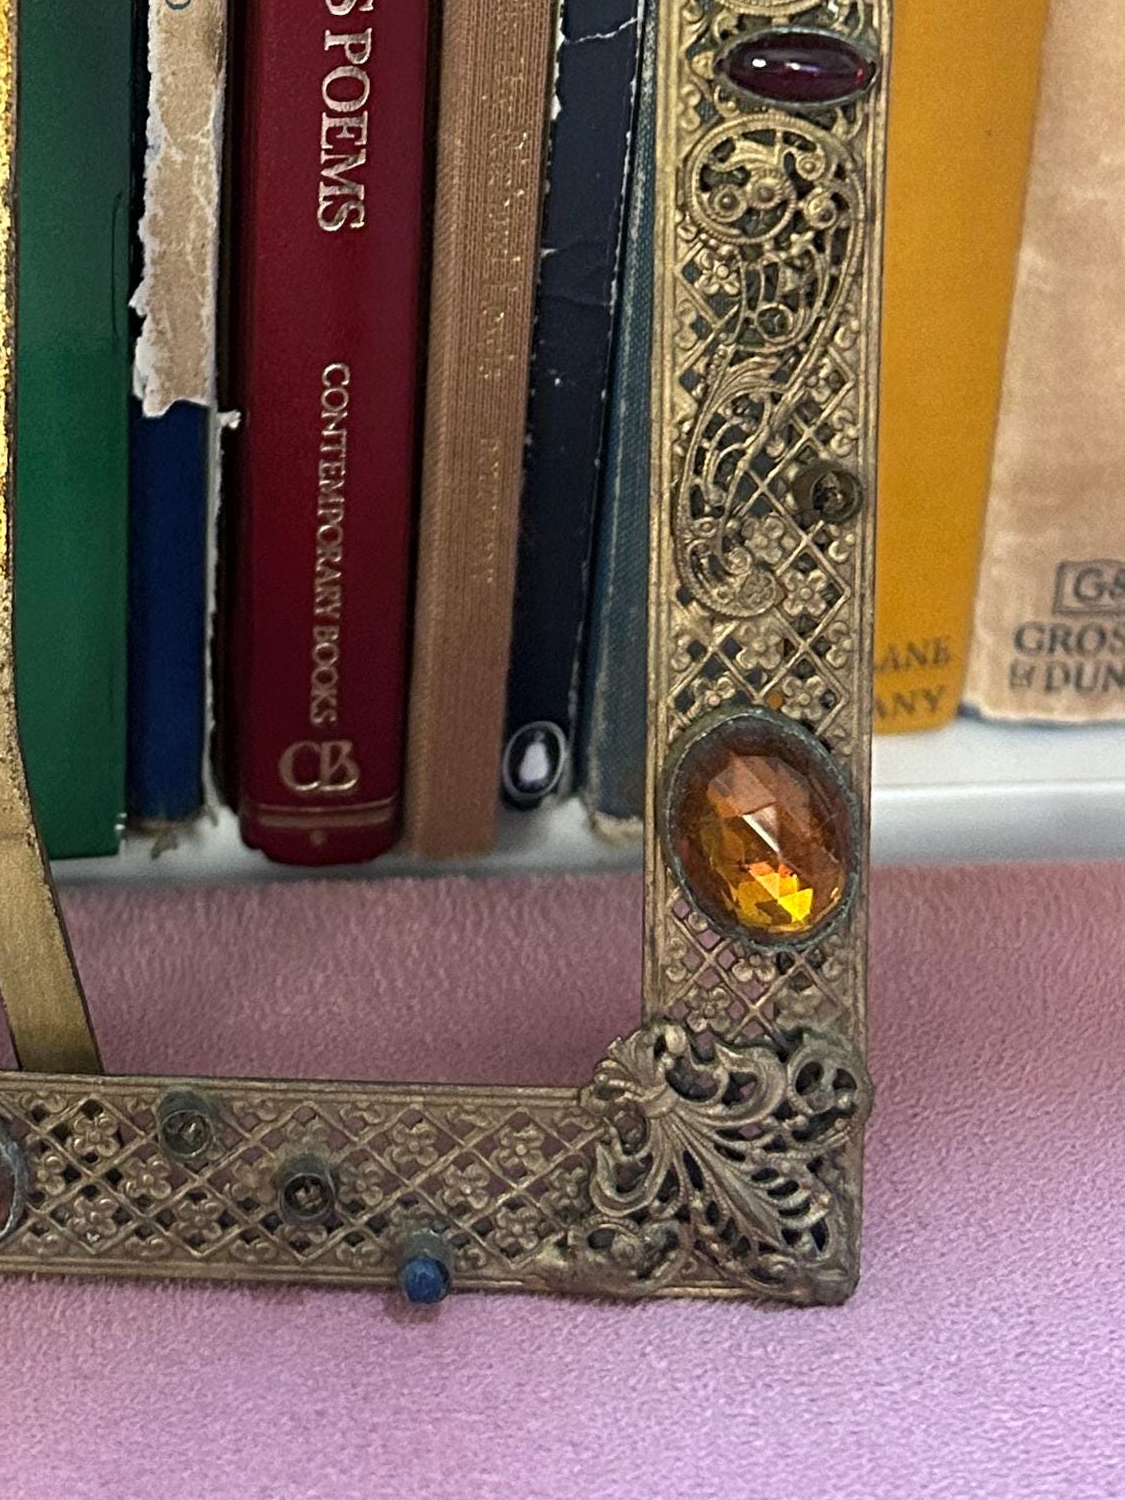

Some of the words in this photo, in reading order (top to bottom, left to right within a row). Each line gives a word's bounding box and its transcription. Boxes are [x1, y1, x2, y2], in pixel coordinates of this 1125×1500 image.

[316, 28, 373, 234] POEMS
[313, 362, 352, 620] CONTEMPORARY
[309, 625, 340, 727] BOOKS
[278, 740, 361, 793] CB
